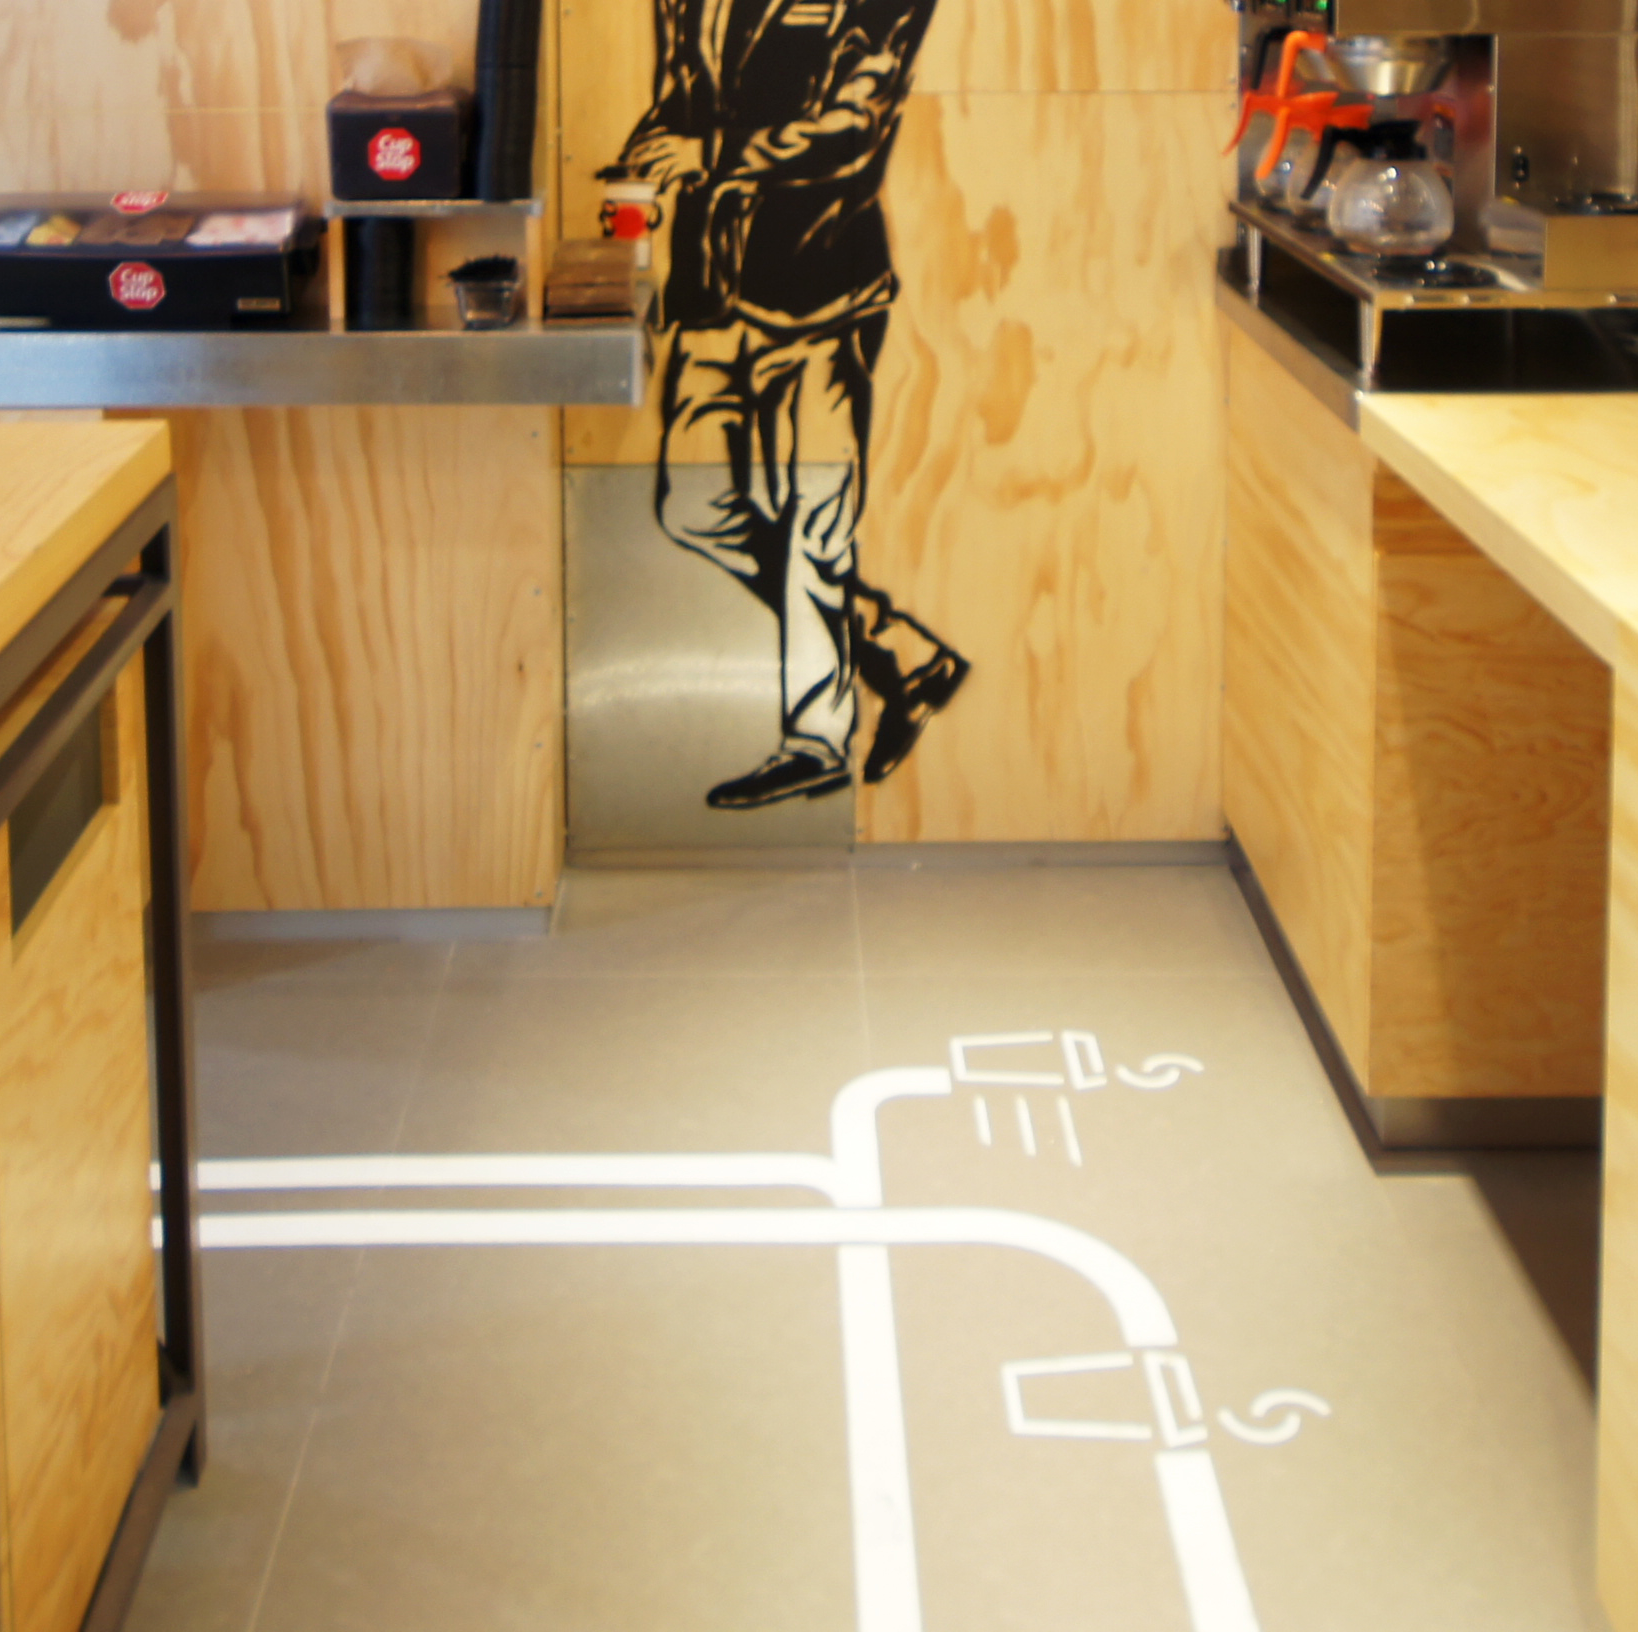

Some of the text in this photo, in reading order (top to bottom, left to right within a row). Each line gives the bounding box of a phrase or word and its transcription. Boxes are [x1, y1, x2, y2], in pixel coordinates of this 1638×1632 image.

[378, 134, 413, 155] Cup
[375, 149, 415, 173] Stop
[120, 268, 154, 287] Cup
[119, 283, 159, 302] Stop
